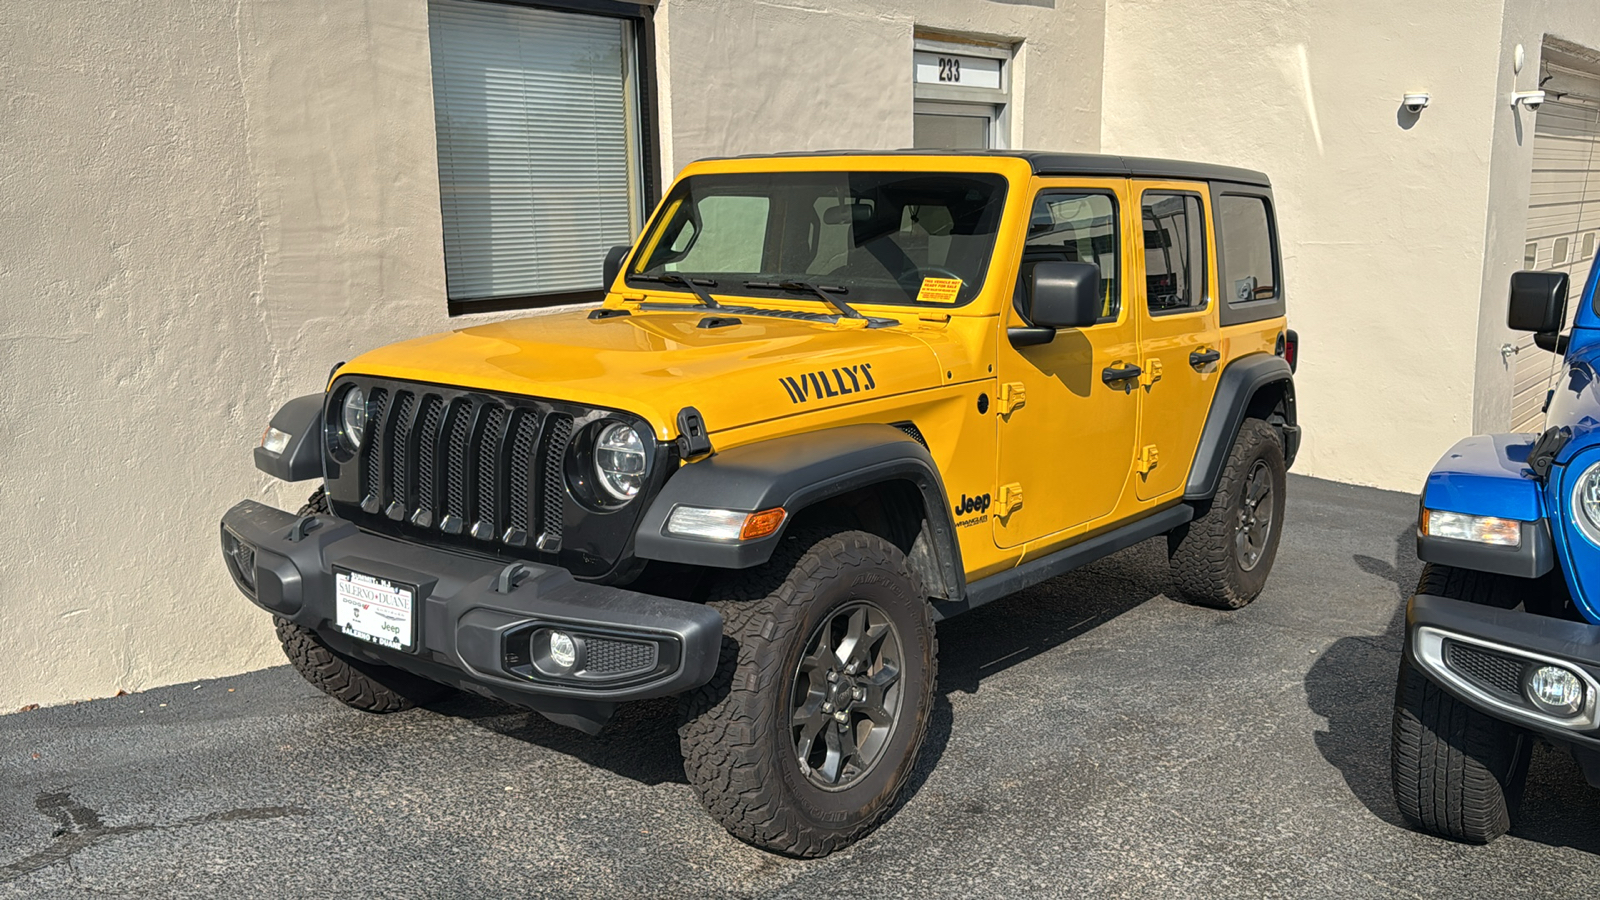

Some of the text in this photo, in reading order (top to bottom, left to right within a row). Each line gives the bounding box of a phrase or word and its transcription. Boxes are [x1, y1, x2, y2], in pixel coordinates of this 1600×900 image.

[939, 58, 960, 82] 233
[778, 363, 875, 404] WILLYS
[955, 493, 991, 516] Jeep
[955, 515, 988, 527] WRANGLER
[339, 582, 410, 610] SALERNO DUANE
[381, 621, 400, 634] Jeep
